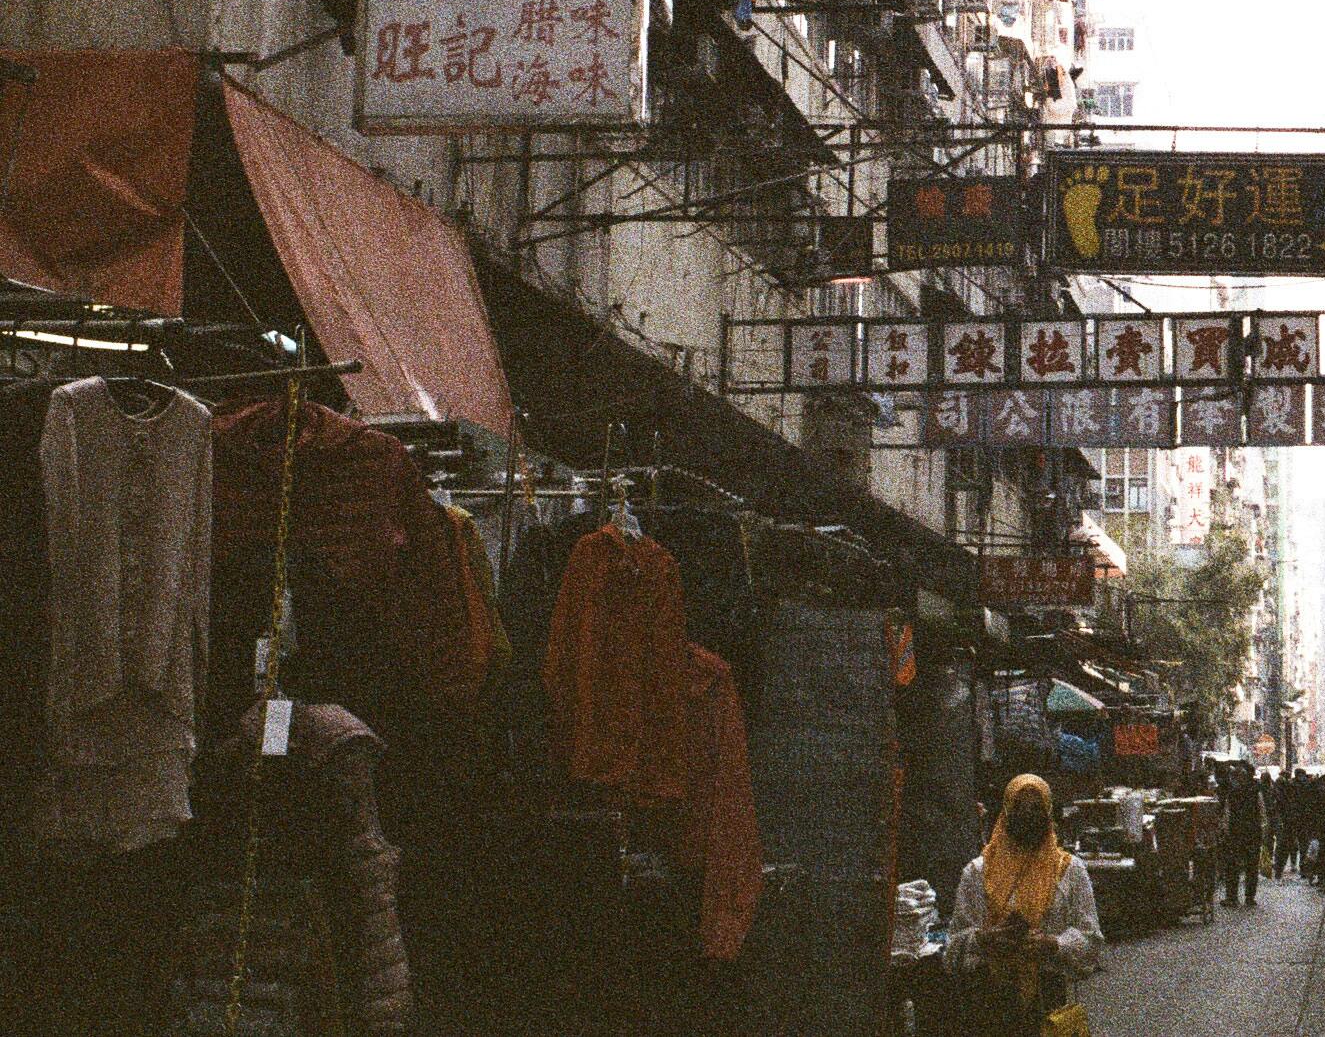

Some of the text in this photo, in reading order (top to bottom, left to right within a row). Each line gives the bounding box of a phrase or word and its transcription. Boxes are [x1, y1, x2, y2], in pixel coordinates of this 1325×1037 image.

[371, 13, 502, 89] 旺記
[511, 51, 620, 108] 海味
[1106, 165, 1304, 226] 足好運
[1168, 232, 1236, 259] 5126
[1248, 232, 1313, 260] 1822
[1186, 453, 1206, 543] 龍祥大
